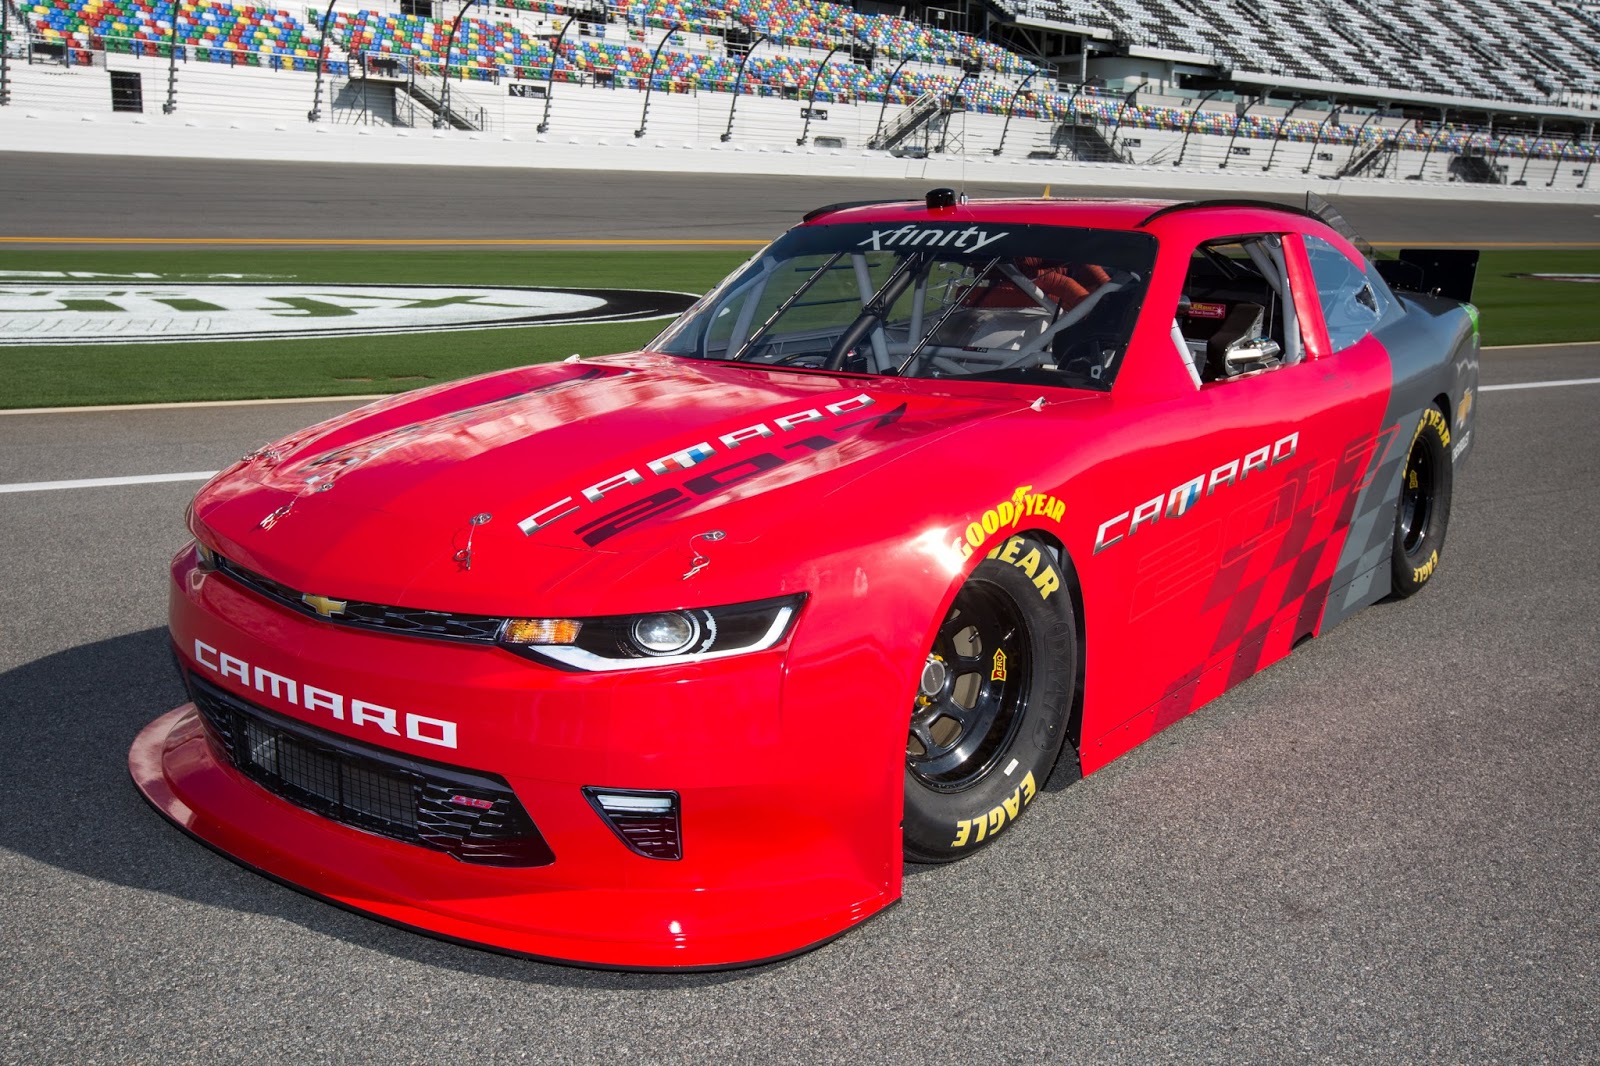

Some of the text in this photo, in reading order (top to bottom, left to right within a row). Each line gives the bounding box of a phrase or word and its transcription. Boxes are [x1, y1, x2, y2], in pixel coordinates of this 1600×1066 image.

[857, 225, 1009, 253] xfinity
[517, 393, 876, 536] CAMARO
[1093, 431, 1299, 556] CAMARO
[1412, 548, 1438, 583] EAGLE
[194, 638, 458, 749] CAMARO
[951, 770, 1036, 847] EAGLE
